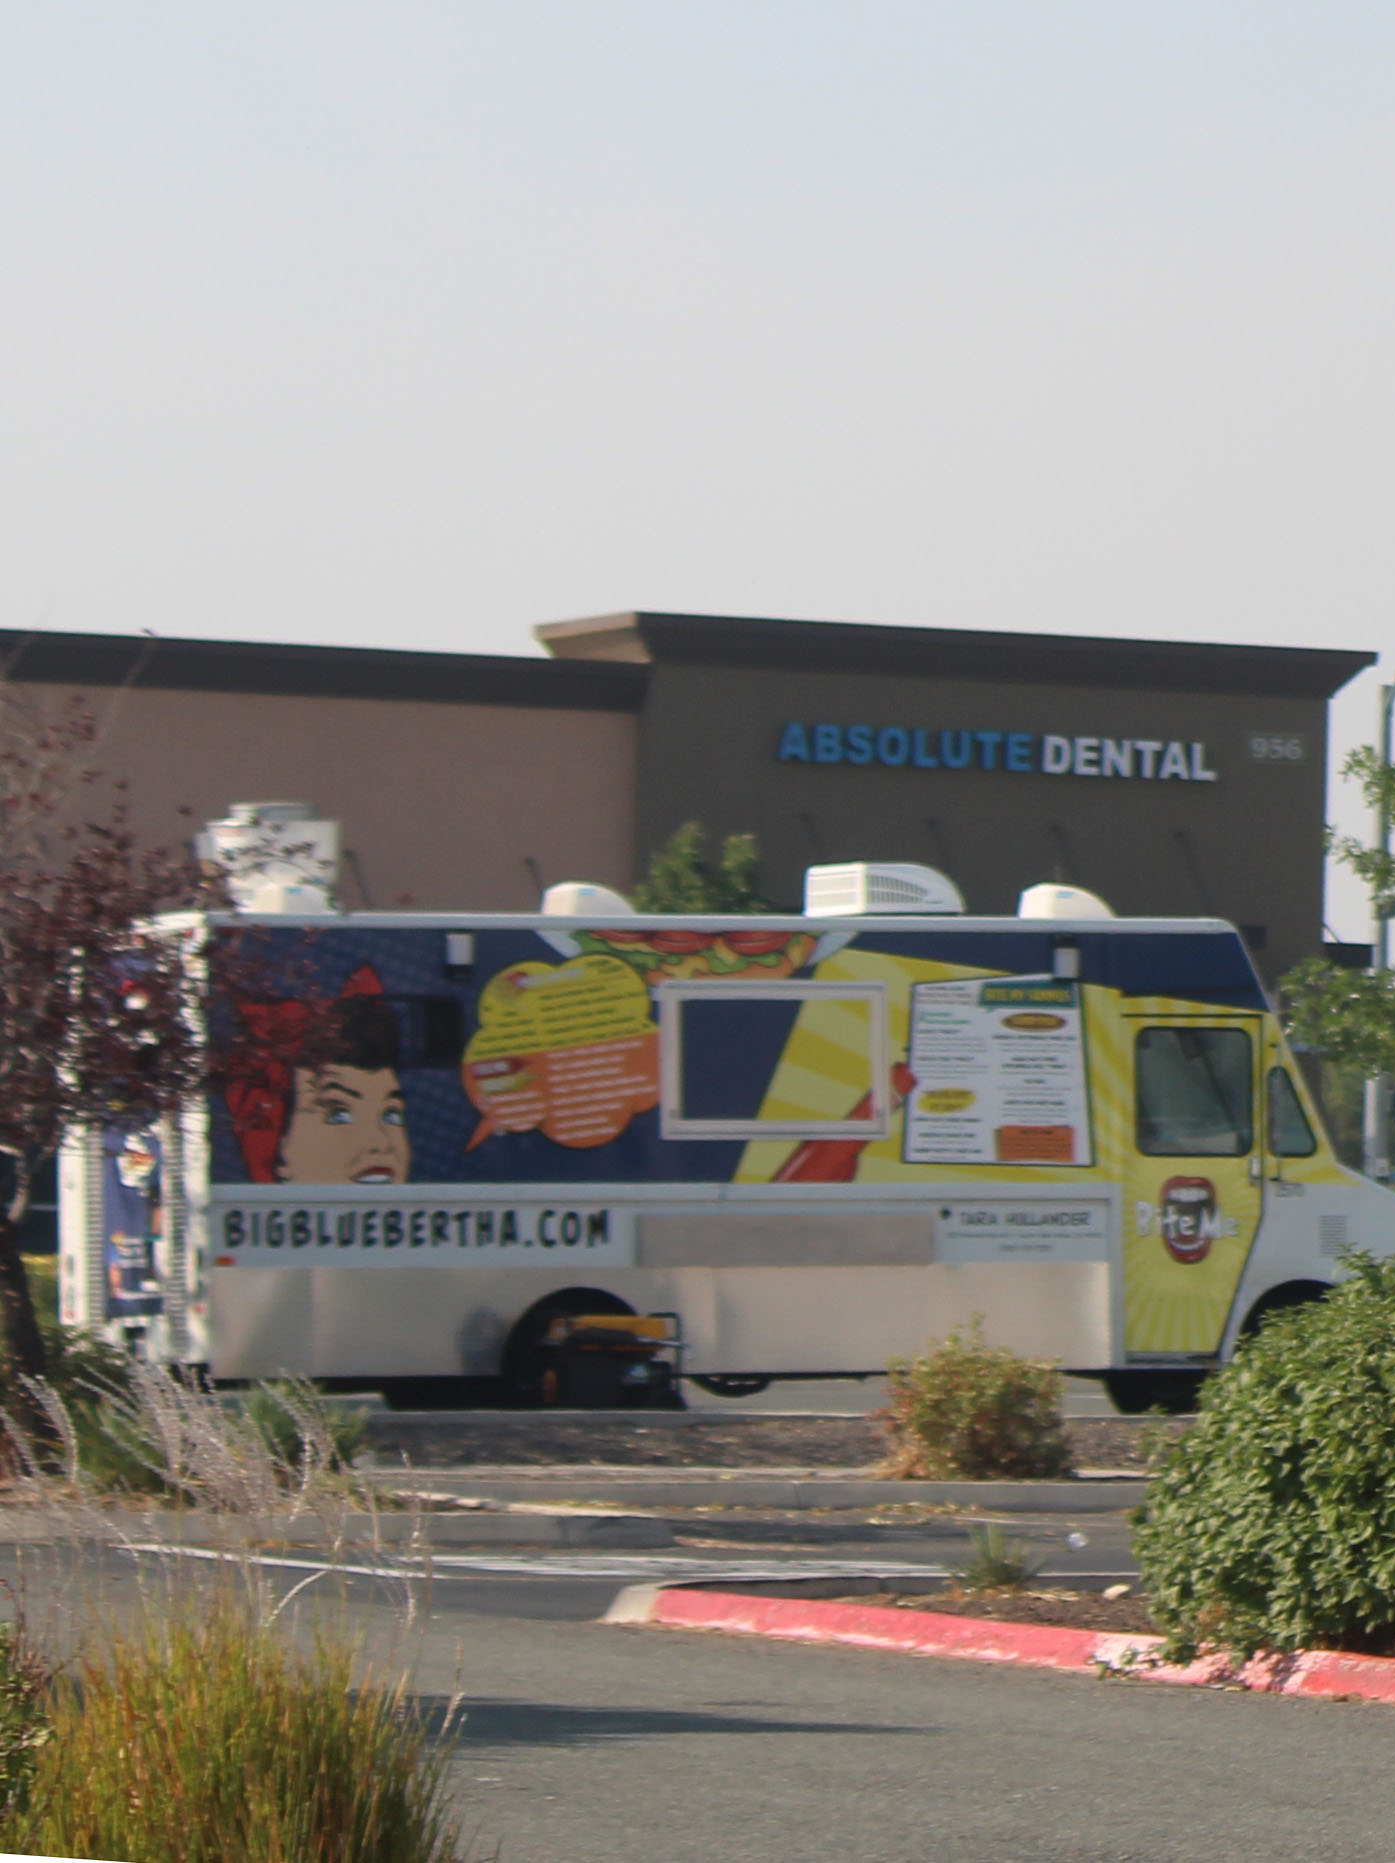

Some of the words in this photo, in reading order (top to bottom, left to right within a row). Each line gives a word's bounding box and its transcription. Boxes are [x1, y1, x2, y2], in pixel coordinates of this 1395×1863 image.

[778, 722, 1033, 773] ABSOLUTE
[1041, 735, 1217, 782] DENTAL
[1249, 737, 1301, 760] 956
[223, 1209, 612, 1249] BIGBLUEBERTHA.COM
[1135, 1200, 1195, 1240] Bite
[1199, 1203, 1240, 1240] Me
